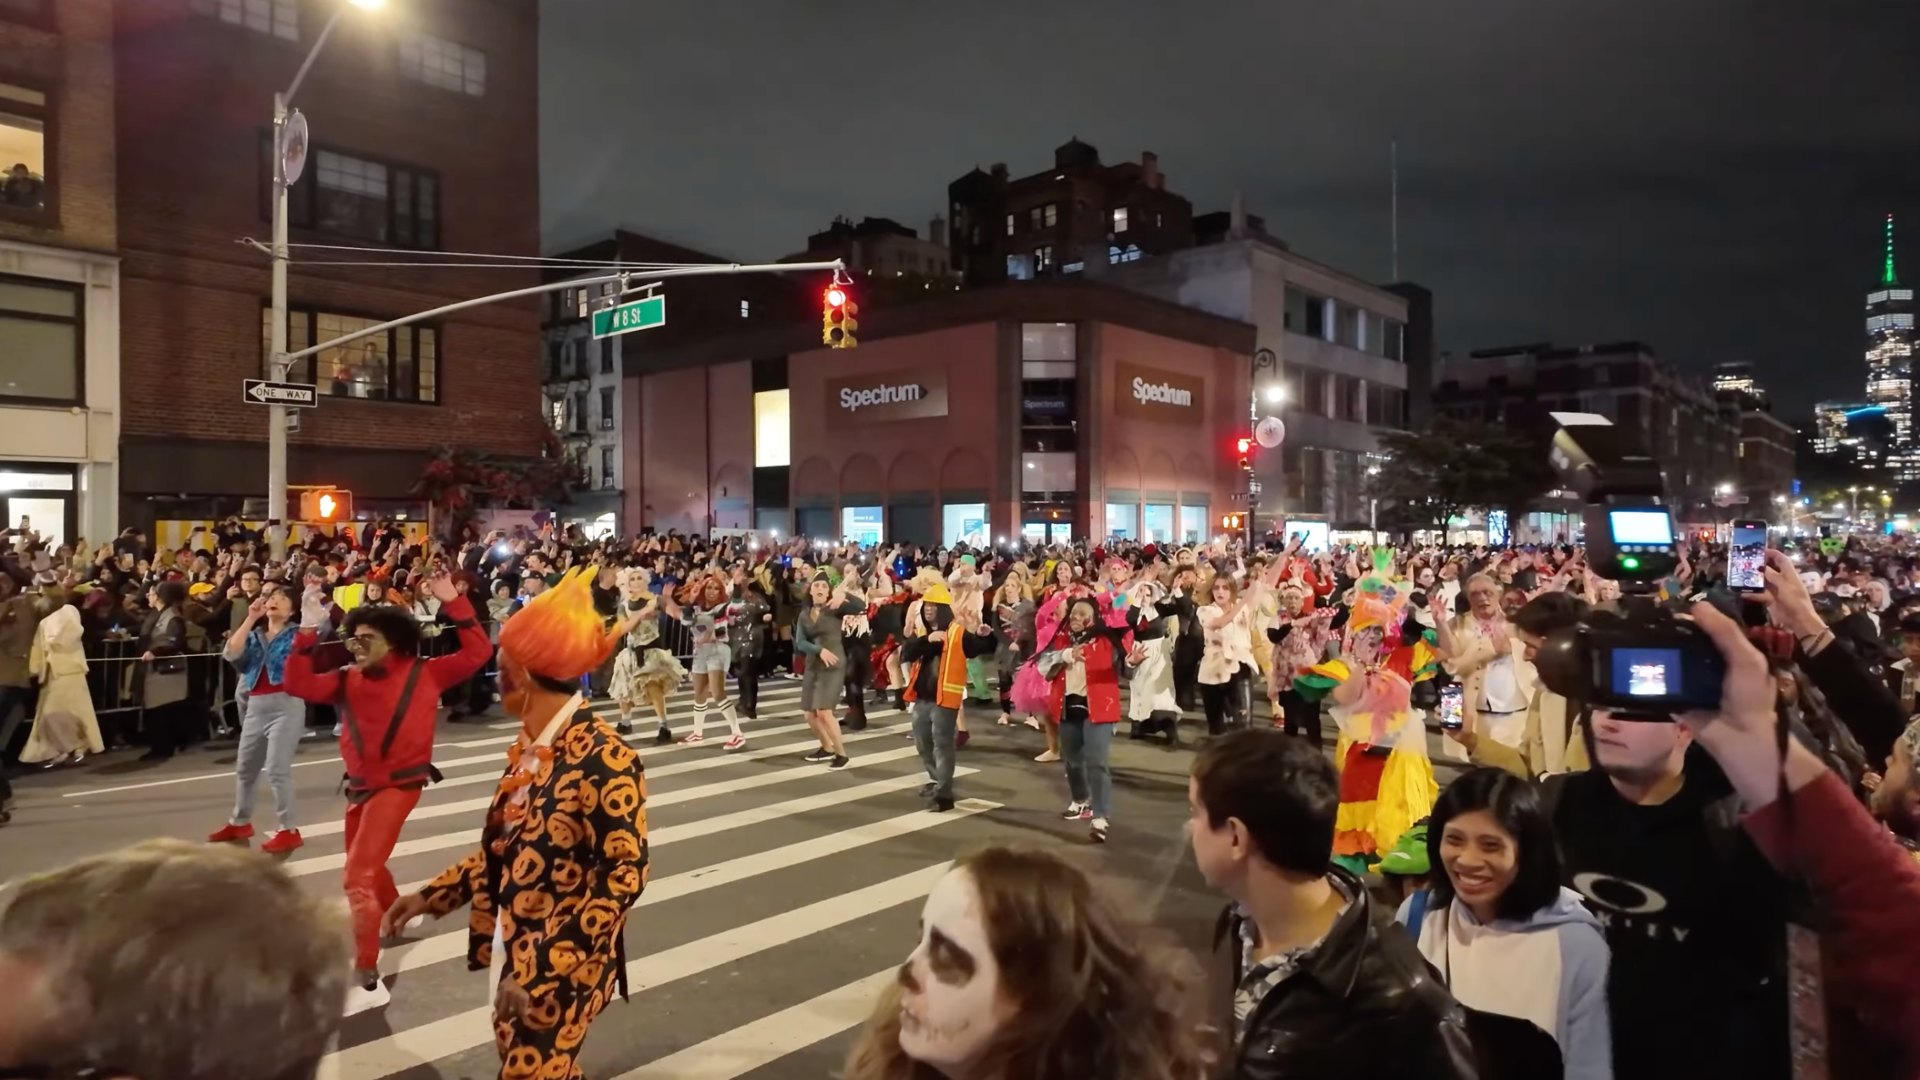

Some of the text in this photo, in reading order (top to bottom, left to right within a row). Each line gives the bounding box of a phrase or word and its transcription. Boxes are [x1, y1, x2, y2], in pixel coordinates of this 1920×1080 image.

[622, 310, 628, 326] 8
[631, 307, 641, 324] St
[256, 387, 307, 400] ONE WAY
[840, 383, 919, 412] Spectrum
[1132, 376, 1191, 407] Spectrum
